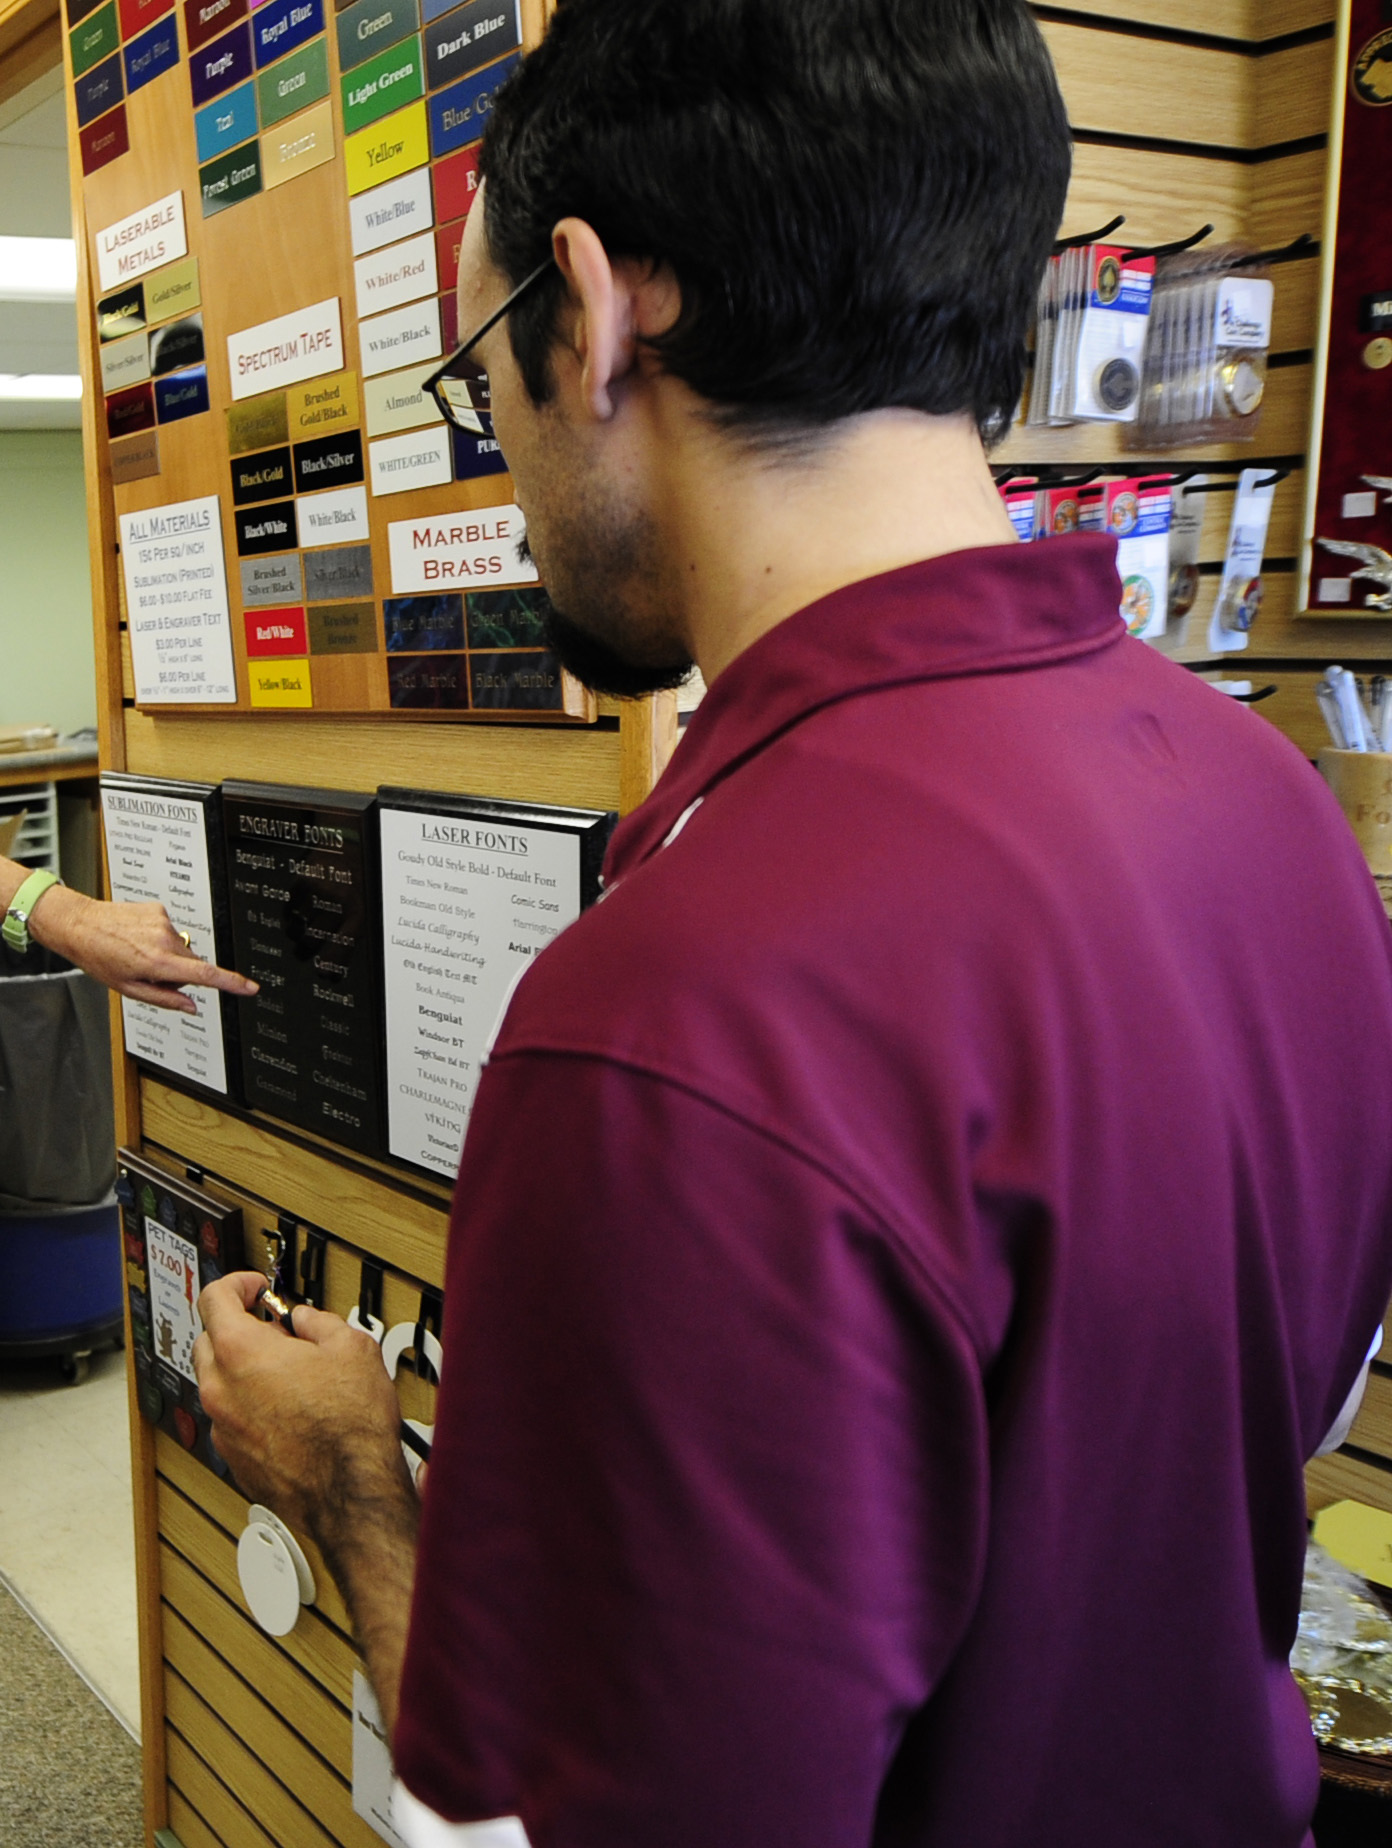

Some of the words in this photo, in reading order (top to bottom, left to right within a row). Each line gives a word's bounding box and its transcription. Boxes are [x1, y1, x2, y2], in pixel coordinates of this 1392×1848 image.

[261, 16, 288, 45] Royal
[290, 3, 312, 26] Blue
[358, 11, 393, 40] Green
[437, 31, 471, 60] Dark
[473, 14, 506, 40] Blue
[206, 53, 234, 79] Purple
[278, 71, 306, 97] Green
[348, 80, 378, 107] Light
[379, 63, 413, 88] Green
[366, 139, 405, 167] Yellow
[203, 176, 230, 200] Forest
[231, 163, 256, 185] Green
[365, 200, 416, 229] White/Blue
[104, 205, 175, 253] LASERABLE
[118, 241, 165, 275] METALS
[365, 259, 426, 290] White/Red
[369, 325, 431, 352] White/Black
[238, 340, 299, 375] SPECTRUM
[300, 328, 333, 355] TAPE
[304, 386, 340, 407] Brushed
[384, 390, 423, 412] Almond
[300, 405, 348, 426] Gold/Black
[301, 453, 354, 474] Black/Silver
[378, 450, 441, 474] WHITE/GREEN
[240, 467, 284, 488] Black/Gold
[129, 522, 148, 541] ALL
[150, 510, 210, 536] MATERIALS
[308, 508, 356, 527] White/Black
[244, 520, 288, 540] Black/White
[412, 520, 511, 550] MARBLE
[254, 567, 287, 580] Brushed
[423, 556, 503, 580] BRASS
[247, 581, 295, 596] Silver/Black
[203, 612, 222, 625] TEXT
[420, 614, 454, 630] Marble
[256, 626, 295, 641] Red/White
[258, 678, 302, 691] Yellow/Black
[421, 673, 456, 688] Marble
[475, 673, 507, 688] Black
[514, 672, 554, 689] Marble
[107, 795, 166, 815] SUBLIMATION
[168, 804, 198, 821] FONTS
[239, 814, 299, 841] ENGRAVER
[304, 824, 344, 848] FONTS
[421, 823, 471, 845] LASER
[475, 830, 528, 854] FONTS
[236, 849, 275, 870] Benguiat
[289, 858, 325, 879] Default
[329, 866, 352, 885] Font
[398, 850, 425, 865] Goudy
[427, 855, 443, 868] Old
[445, 858, 466, 873] Style
[468, 861, 490, 876] Bold
[497, 867, 531, 883] Default
[534, 873, 557, 888] Font
[262, 884, 291, 902] Garde
[406, 875, 425, 887] Times
[426, 879, 442, 890] New
[443, 882, 468, 895] Roman
[400, 895, 436, 911] Bookman
[438, 902, 453, 914] Old
[455, 904, 476, 919] Style
[511, 894, 536, 909] Comic
[538, 899, 560, 913] Sans
[397, 916, 426, 930] Lucida
[427, 921, 480, 945] Calligraphy
[391, 935, 423, 951] Lucida
[508, 942, 531, 955] Arial
[314, 955, 349, 978] Century
[312, 984, 355, 1007] Rockwell
[416, 982, 433, 996] Book
[436, 988, 465, 1004] Antiqua
[418, 1005, 463, 1026] Benguiat
[452, 1037, 465, 1048] BT
[417, 1067, 448, 1086] TRAJAN
[450, 1078, 468, 1093] PRO
[322, 1102, 361, 1127] Electro
[148, 1222, 166, 1244] PET
[169, 1233, 195, 1262] TAGS
